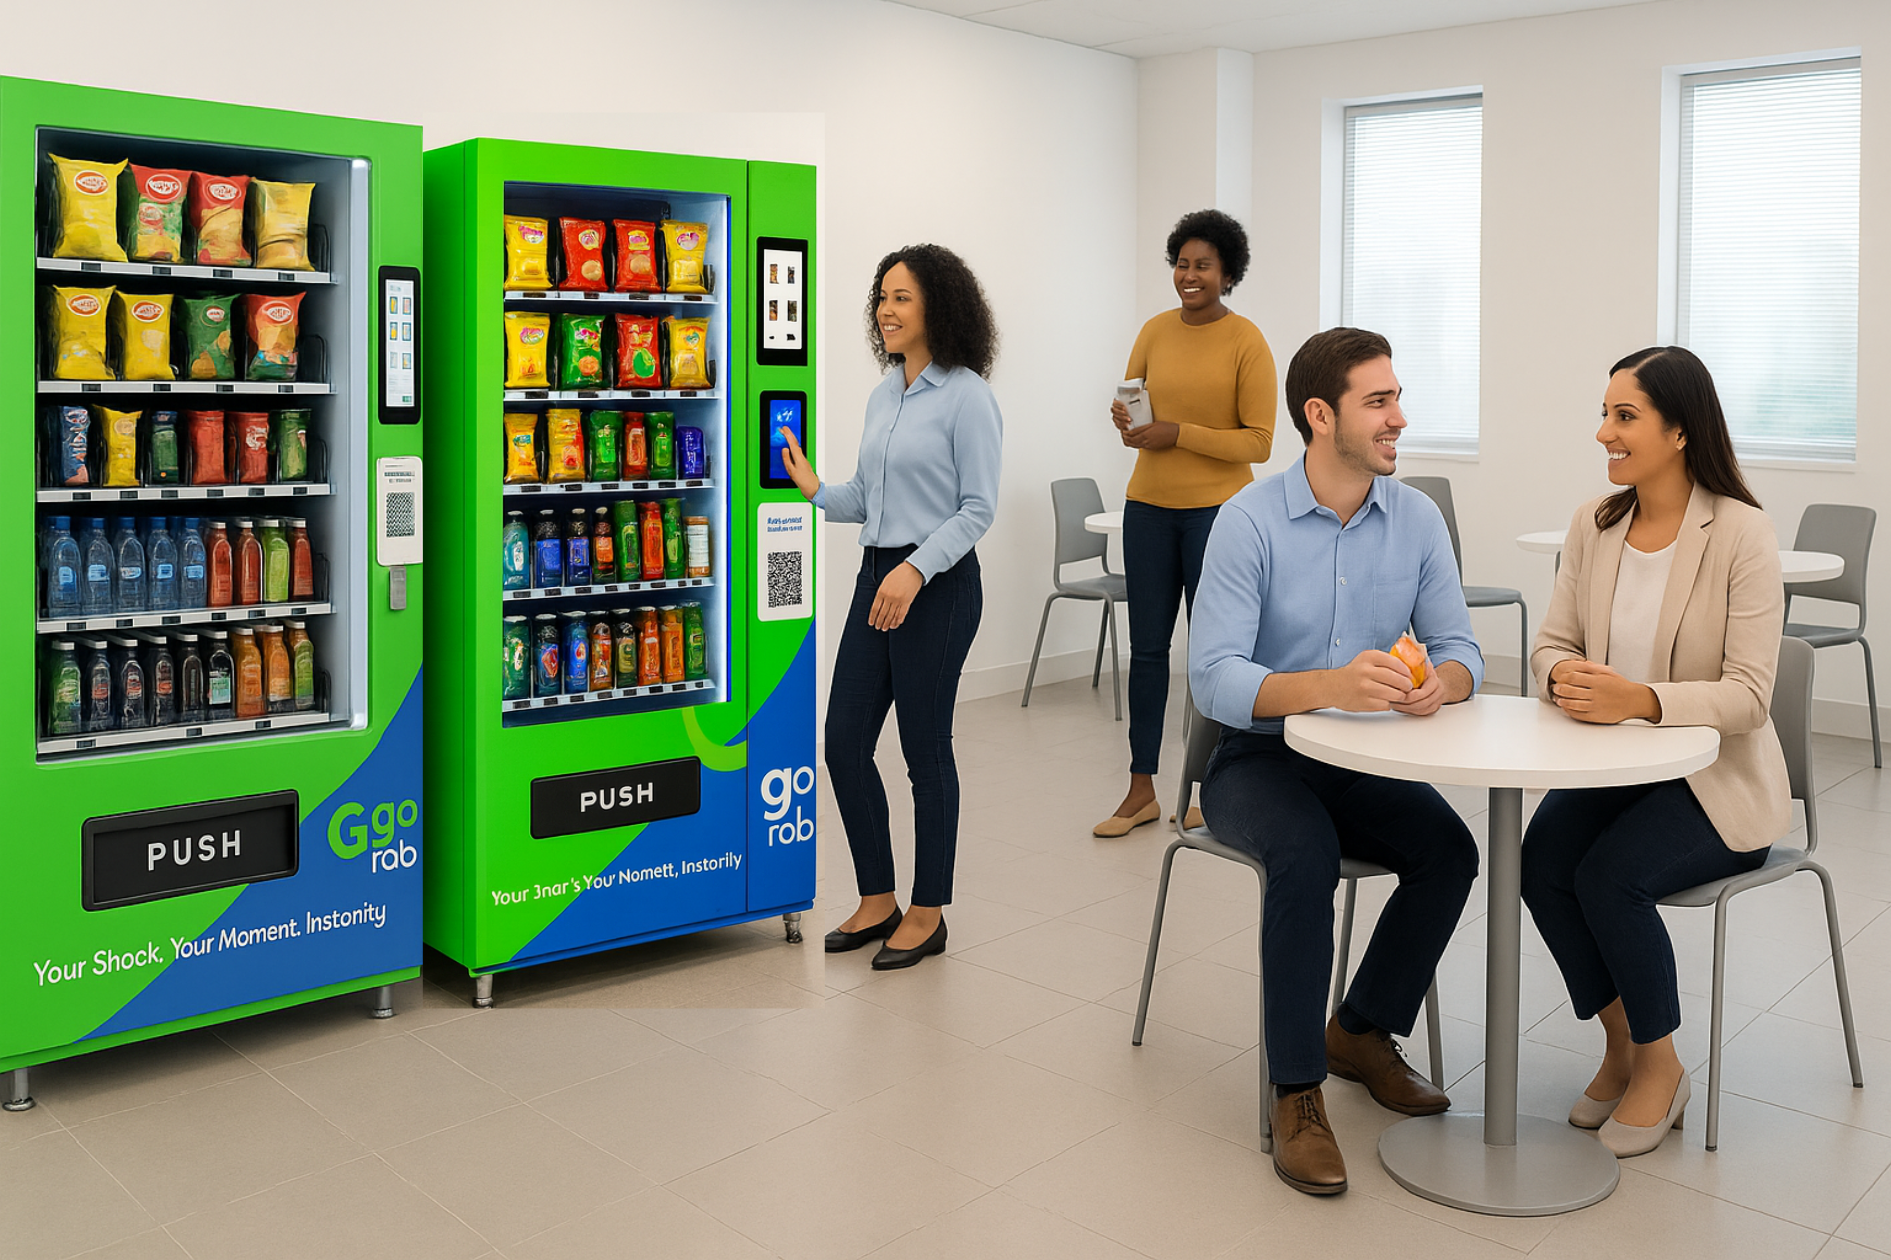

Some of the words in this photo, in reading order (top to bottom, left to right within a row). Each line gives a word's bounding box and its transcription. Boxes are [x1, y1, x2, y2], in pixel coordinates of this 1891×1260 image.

[580, 782, 654, 813] PUSH
[760, 765, 815, 821] go
[768, 805, 815, 847] rob
[147, 829, 242, 872] PUSH
[372, 839, 418, 874] rab
[491, 888, 530, 906] Your
[33, 959, 87, 987] Your
[169, 936, 215, 960] Your
[306, 901, 387, 935] Instonity
